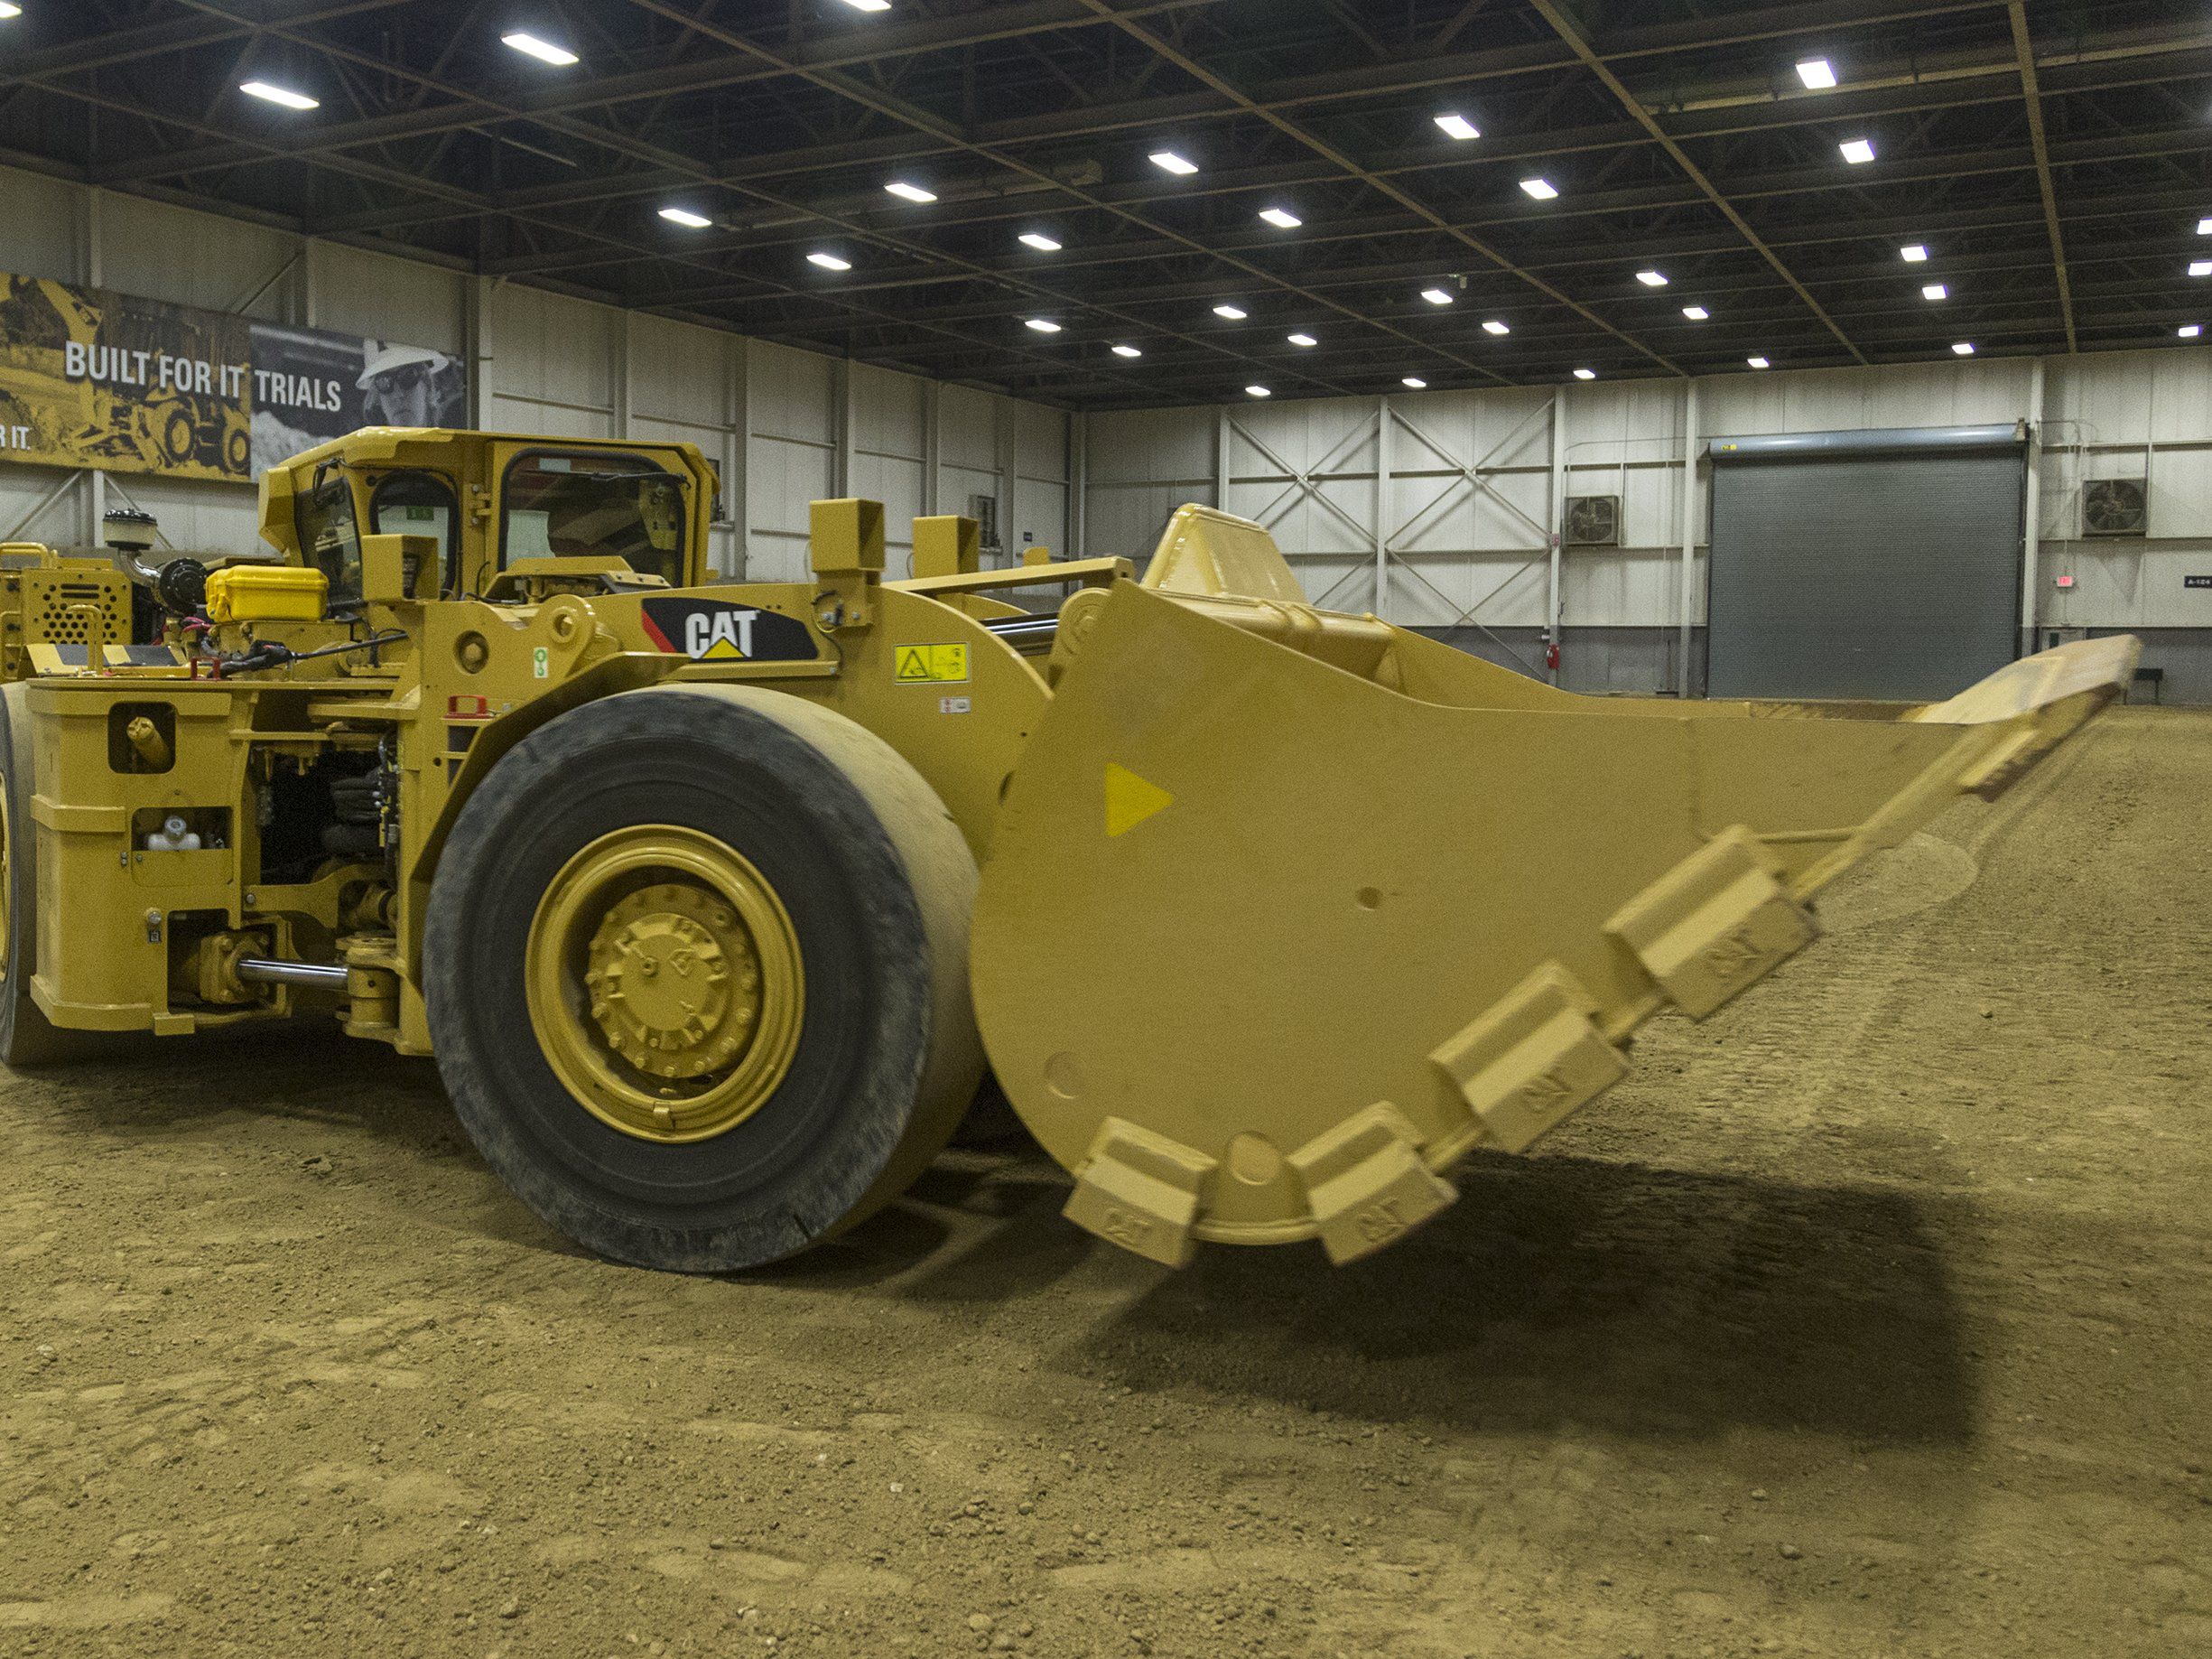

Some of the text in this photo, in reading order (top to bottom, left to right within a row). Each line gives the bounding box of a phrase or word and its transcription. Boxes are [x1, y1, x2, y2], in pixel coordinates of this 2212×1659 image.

[66, 340, 341, 413] BUILT FOR IT TRIALS
[685, 610, 760, 659] CAT
